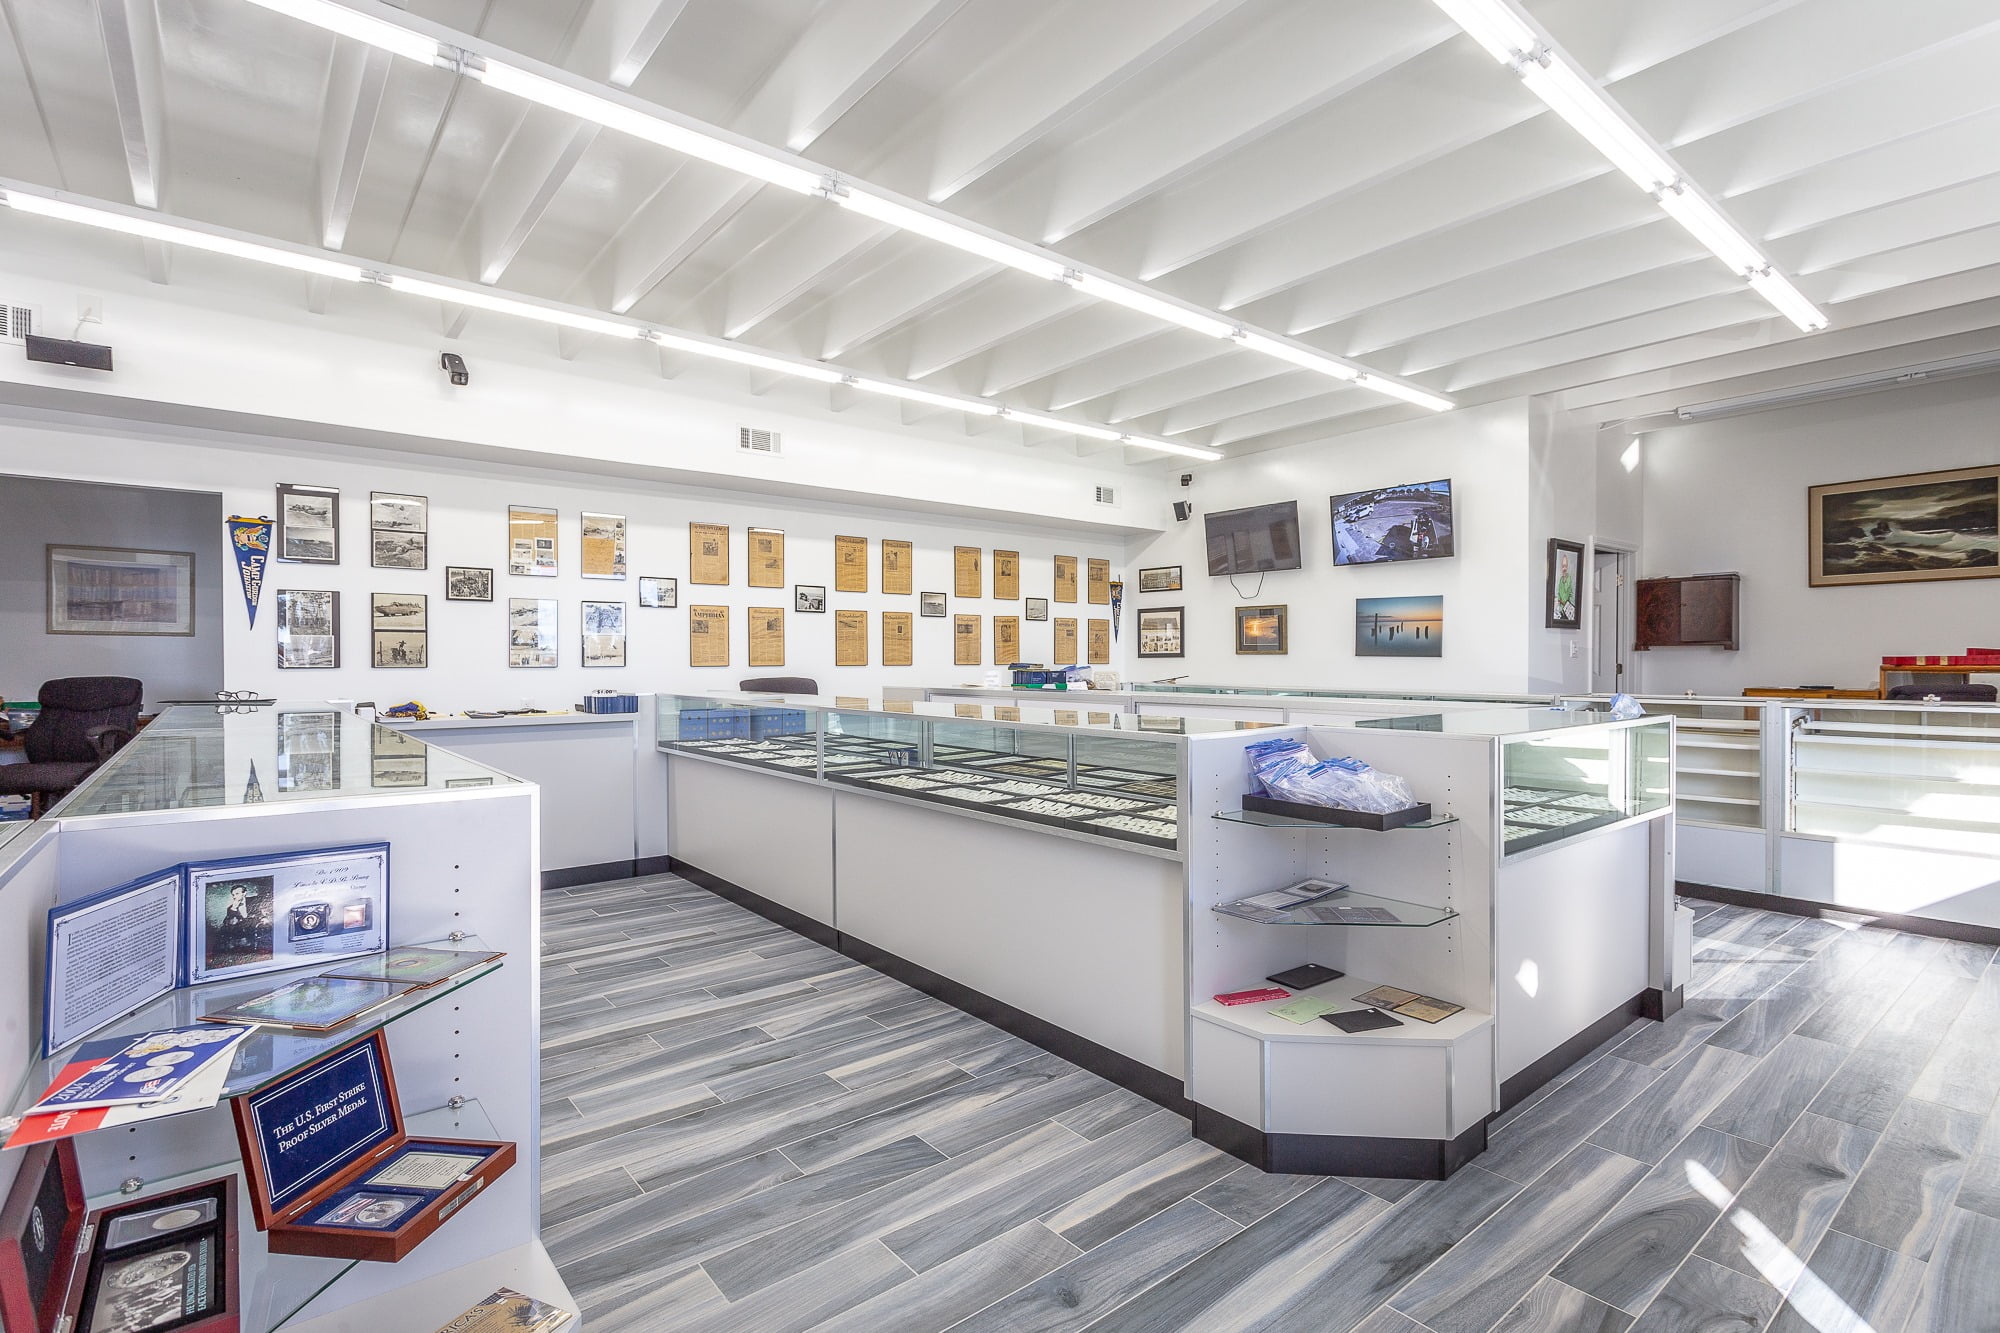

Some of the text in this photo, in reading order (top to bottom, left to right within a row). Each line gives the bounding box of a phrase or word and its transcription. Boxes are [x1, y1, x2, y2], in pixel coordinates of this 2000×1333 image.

[250, 555, 265, 580] CAMP
[273, 1082, 366, 1139] THE U.S. FIRST STRIKE
[278, 1096, 368, 1154] PROOF SILVER MEDAL
